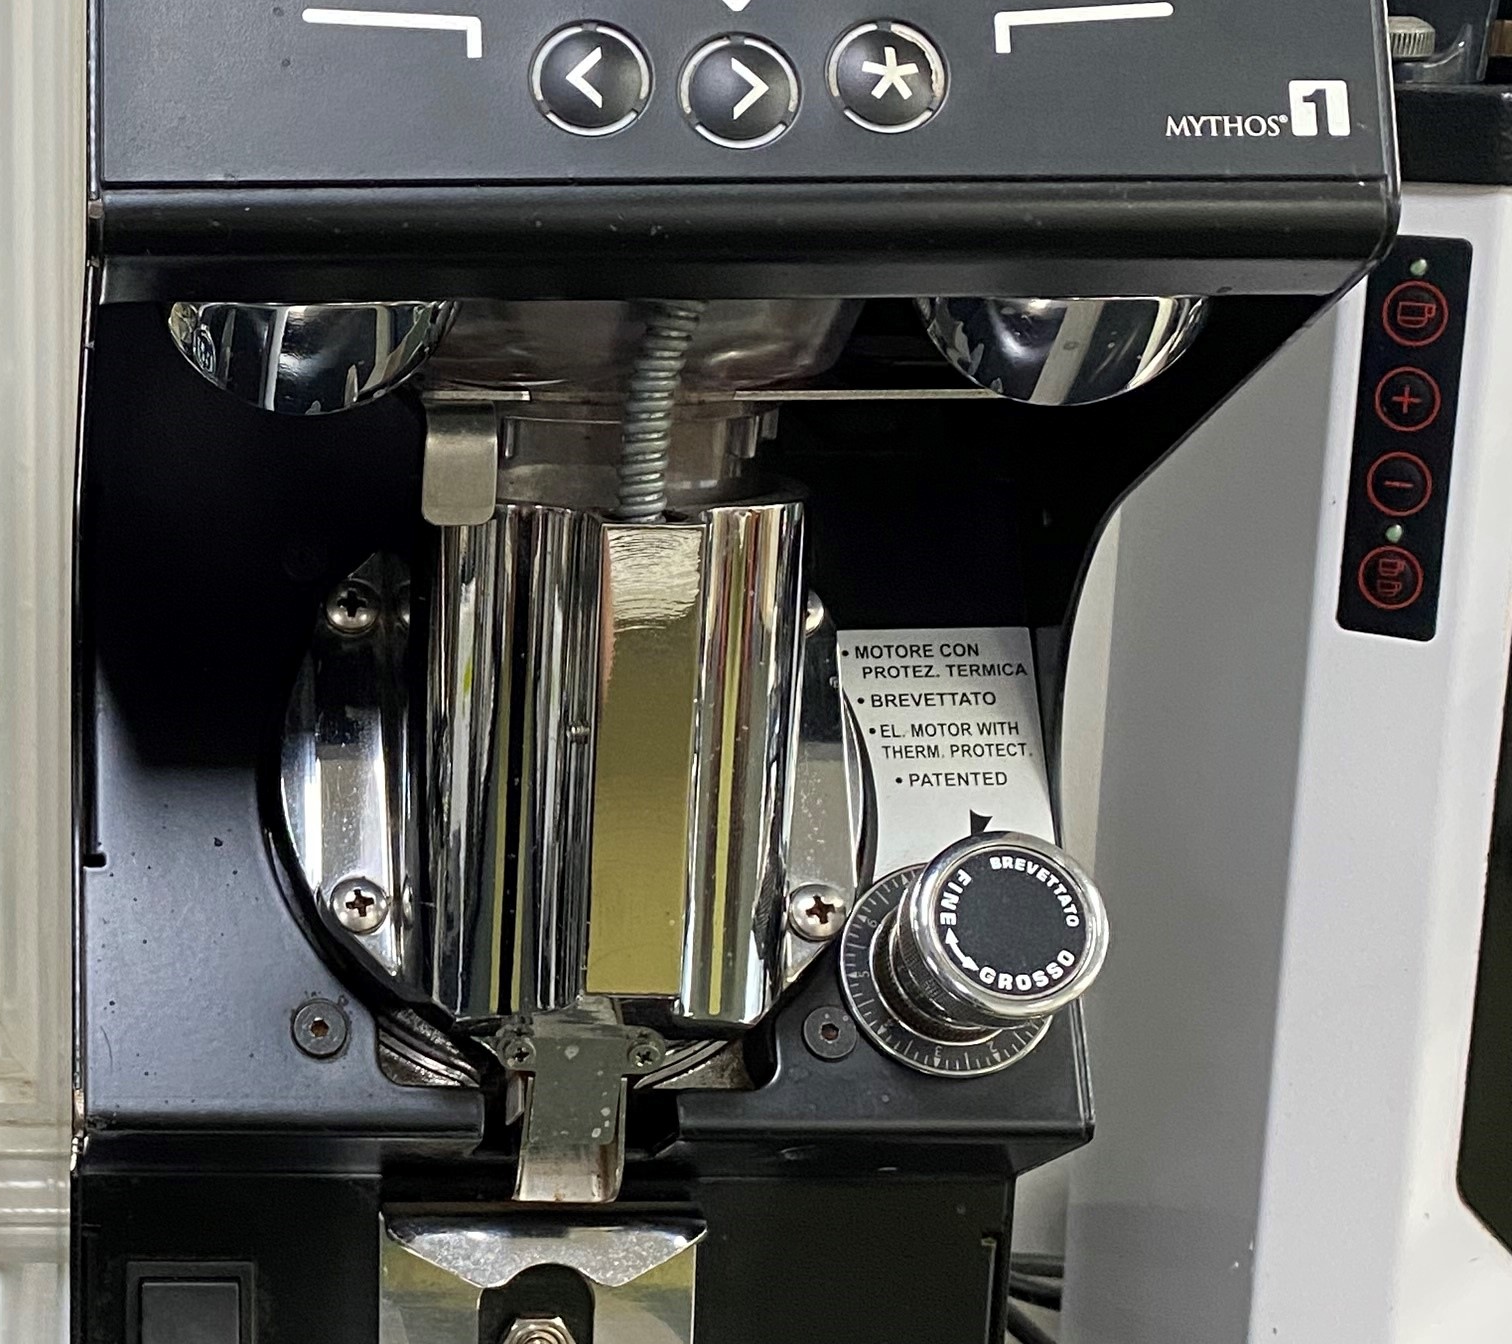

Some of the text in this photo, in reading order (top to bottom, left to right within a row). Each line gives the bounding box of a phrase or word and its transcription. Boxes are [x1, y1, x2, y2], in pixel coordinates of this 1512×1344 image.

[855, 643, 980, 659] MOTORE CON
[862, 663, 1028, 679] PROTEZ. TERMICA
[871, 691, 996, 707] BREVETTATO
[880, 721, 1019, 738] EL. MOTOR WITH
[882, 743, 1033, 759] THERM. PROTECT.
[909, 772, 1007, 787] PATENTED
[940, 869, 972, 926] FINE
[989, 856, 1080, 927] BREVETTATO
[978, 949, 1076, 991] GROSSO
